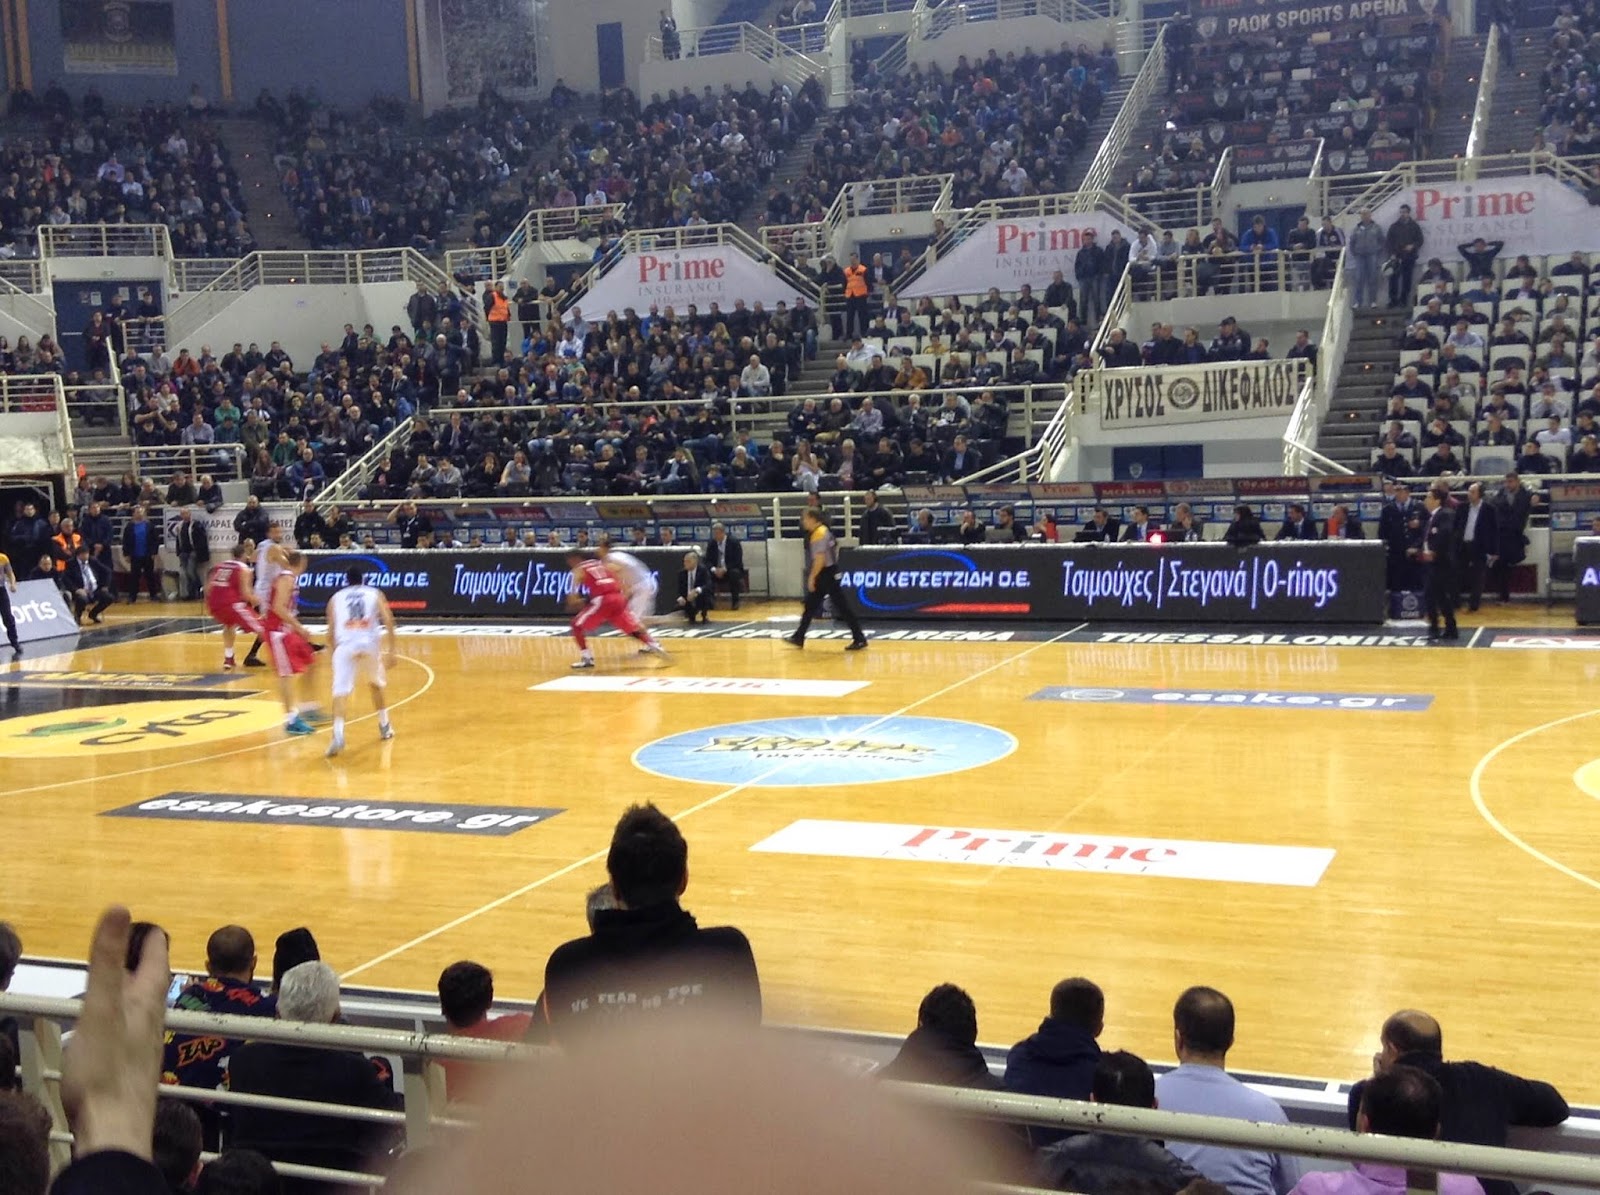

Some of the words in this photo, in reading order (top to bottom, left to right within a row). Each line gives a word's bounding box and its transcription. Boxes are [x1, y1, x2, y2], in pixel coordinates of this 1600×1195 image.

[1228, 14, 1271, 34] PAOK
[1276, 5, 1344, 29] SPORTS
[1414, 185, 1535, 221] Prime
[1422, 219, 1534, 235] NSURANCE
[639, 253, 725, 283] Prime
[995, 255, 1076, 269] INSURAN
[638, 281, 726, 297] INSURANCE
[1105, 374, 1165, 420] ΧΡΥΣΟΣ
[1203, 363, 1294, 412] ΔΙΚΕΦΑΛΟΣ
[315, 572, 402, 588] ΚΕΤΣΤΖΙΔΗ
[886, 571, 993, 587] ΚΕΤΣΕΤΖΙΔΗ
[3, 600, 58, 626] orts
[1151, 691, 1407, 708] esake.gr
[902, 828, 1178, 862] Prime
